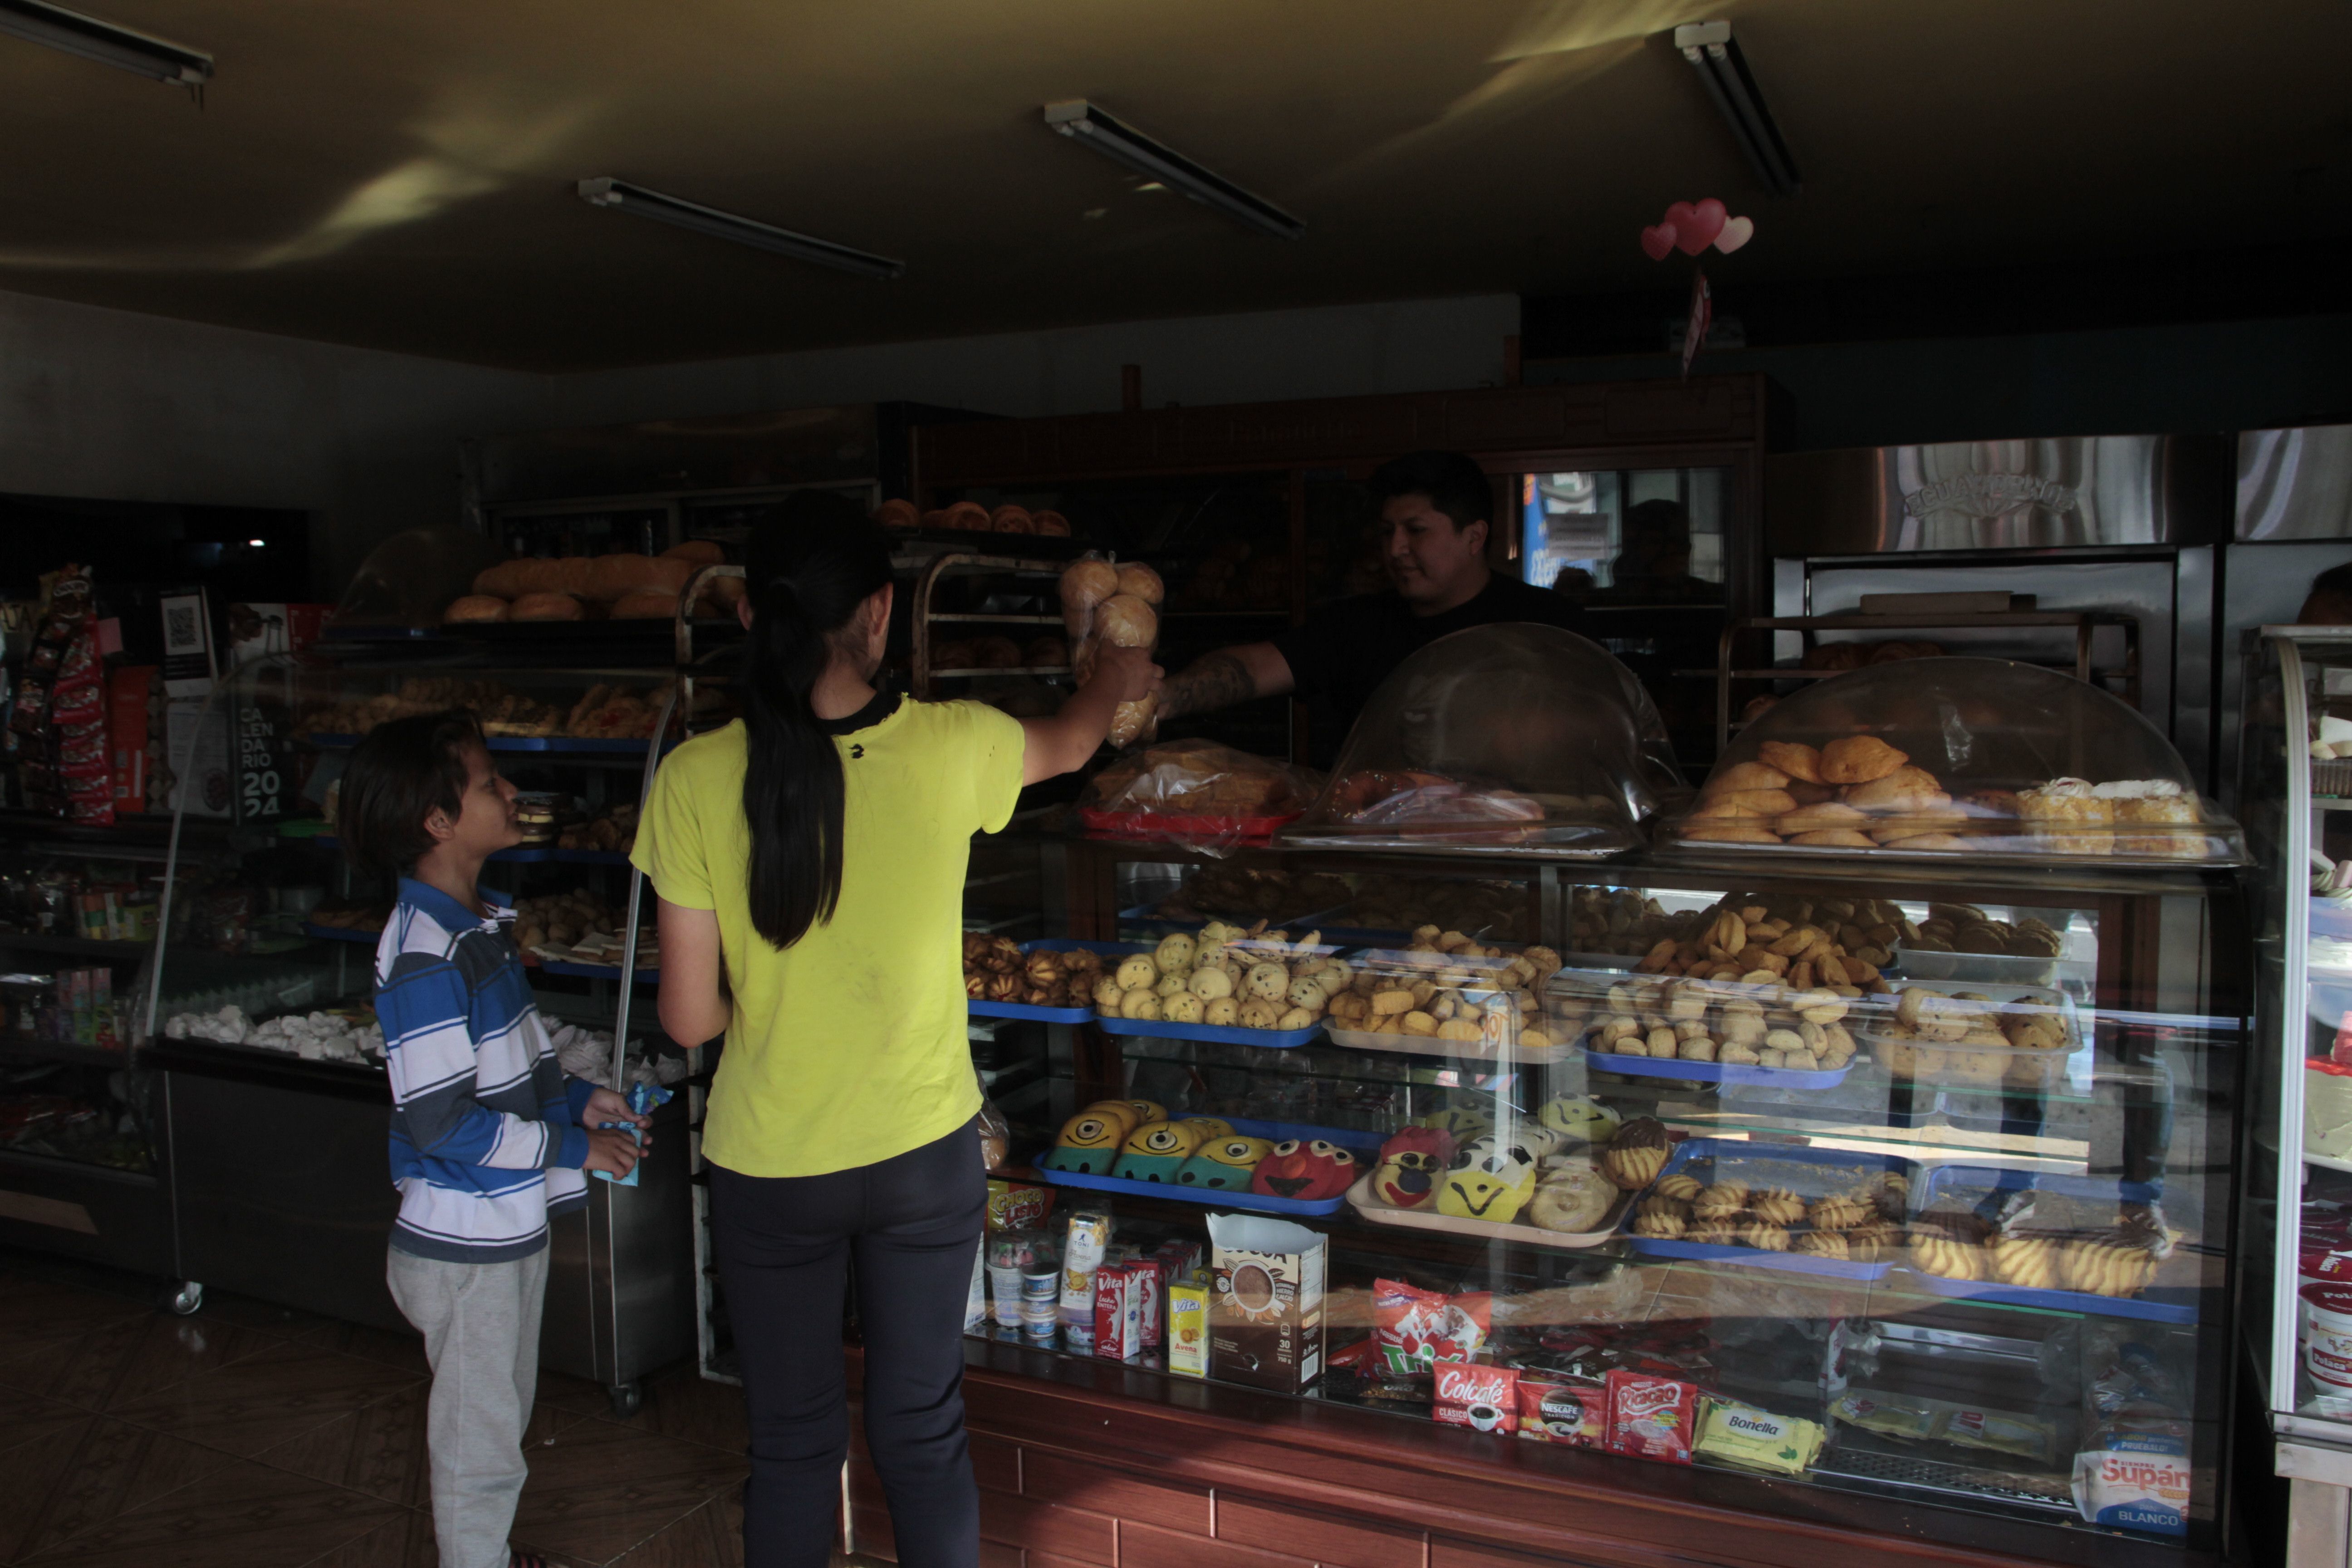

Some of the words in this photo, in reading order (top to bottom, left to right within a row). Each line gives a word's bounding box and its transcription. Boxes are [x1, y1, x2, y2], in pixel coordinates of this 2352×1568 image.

[240, 708, 264, 722] CA
[241, 722, 274, 737] LEN
[241, 738, 265, 753] DA
[242, 753, 271, 768] RIO
[243, 770, 280, 797] 20
[244, 796, 280, 817] 24
[995, 1189, 1043, 1213] CHOCO
[1004, 1203, 1042, 1226] LISTO
[1098, 1276, 1123, 1292] Vita
[1097, 1301, 1117, 1311] ENTERA
[1099, 1294, 1116, 1304] Leche
[1172, 1298, 1200, 1313] Vita
[1175, 1343, 1198, 1353] Avena
[1279, 1339, 1290, 1349] 30
[1439, 1371, 1506, 1403] Colcafé
[1729, 1416, 1779, 1435] Bonella
[2102, 1458, 2190, 1490] Supán
[2118, 1510, 2178, 1526] BLANCO
